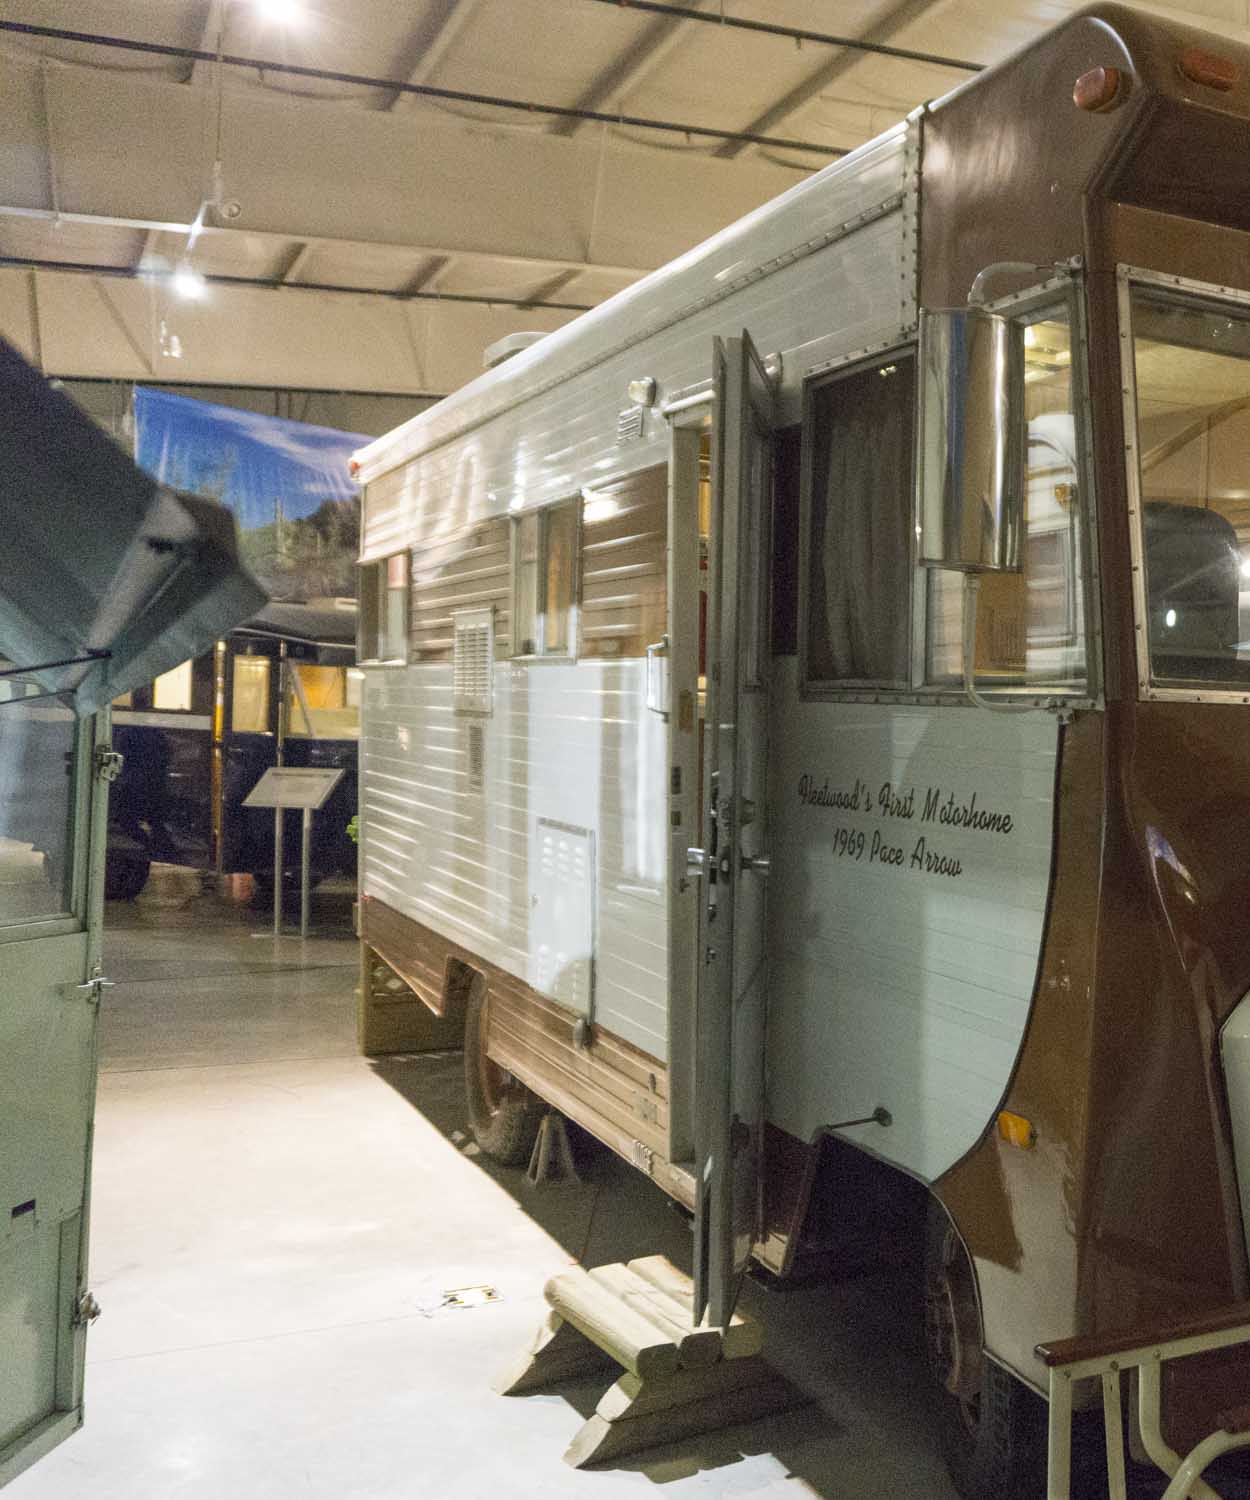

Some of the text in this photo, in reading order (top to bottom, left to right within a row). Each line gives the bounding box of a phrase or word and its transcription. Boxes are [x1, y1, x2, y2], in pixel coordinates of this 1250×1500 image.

[798, 774, 1013, 834] Fleetwood's First Motorhome
[832, 828, 963, 877] 1969 Pace Arrow
